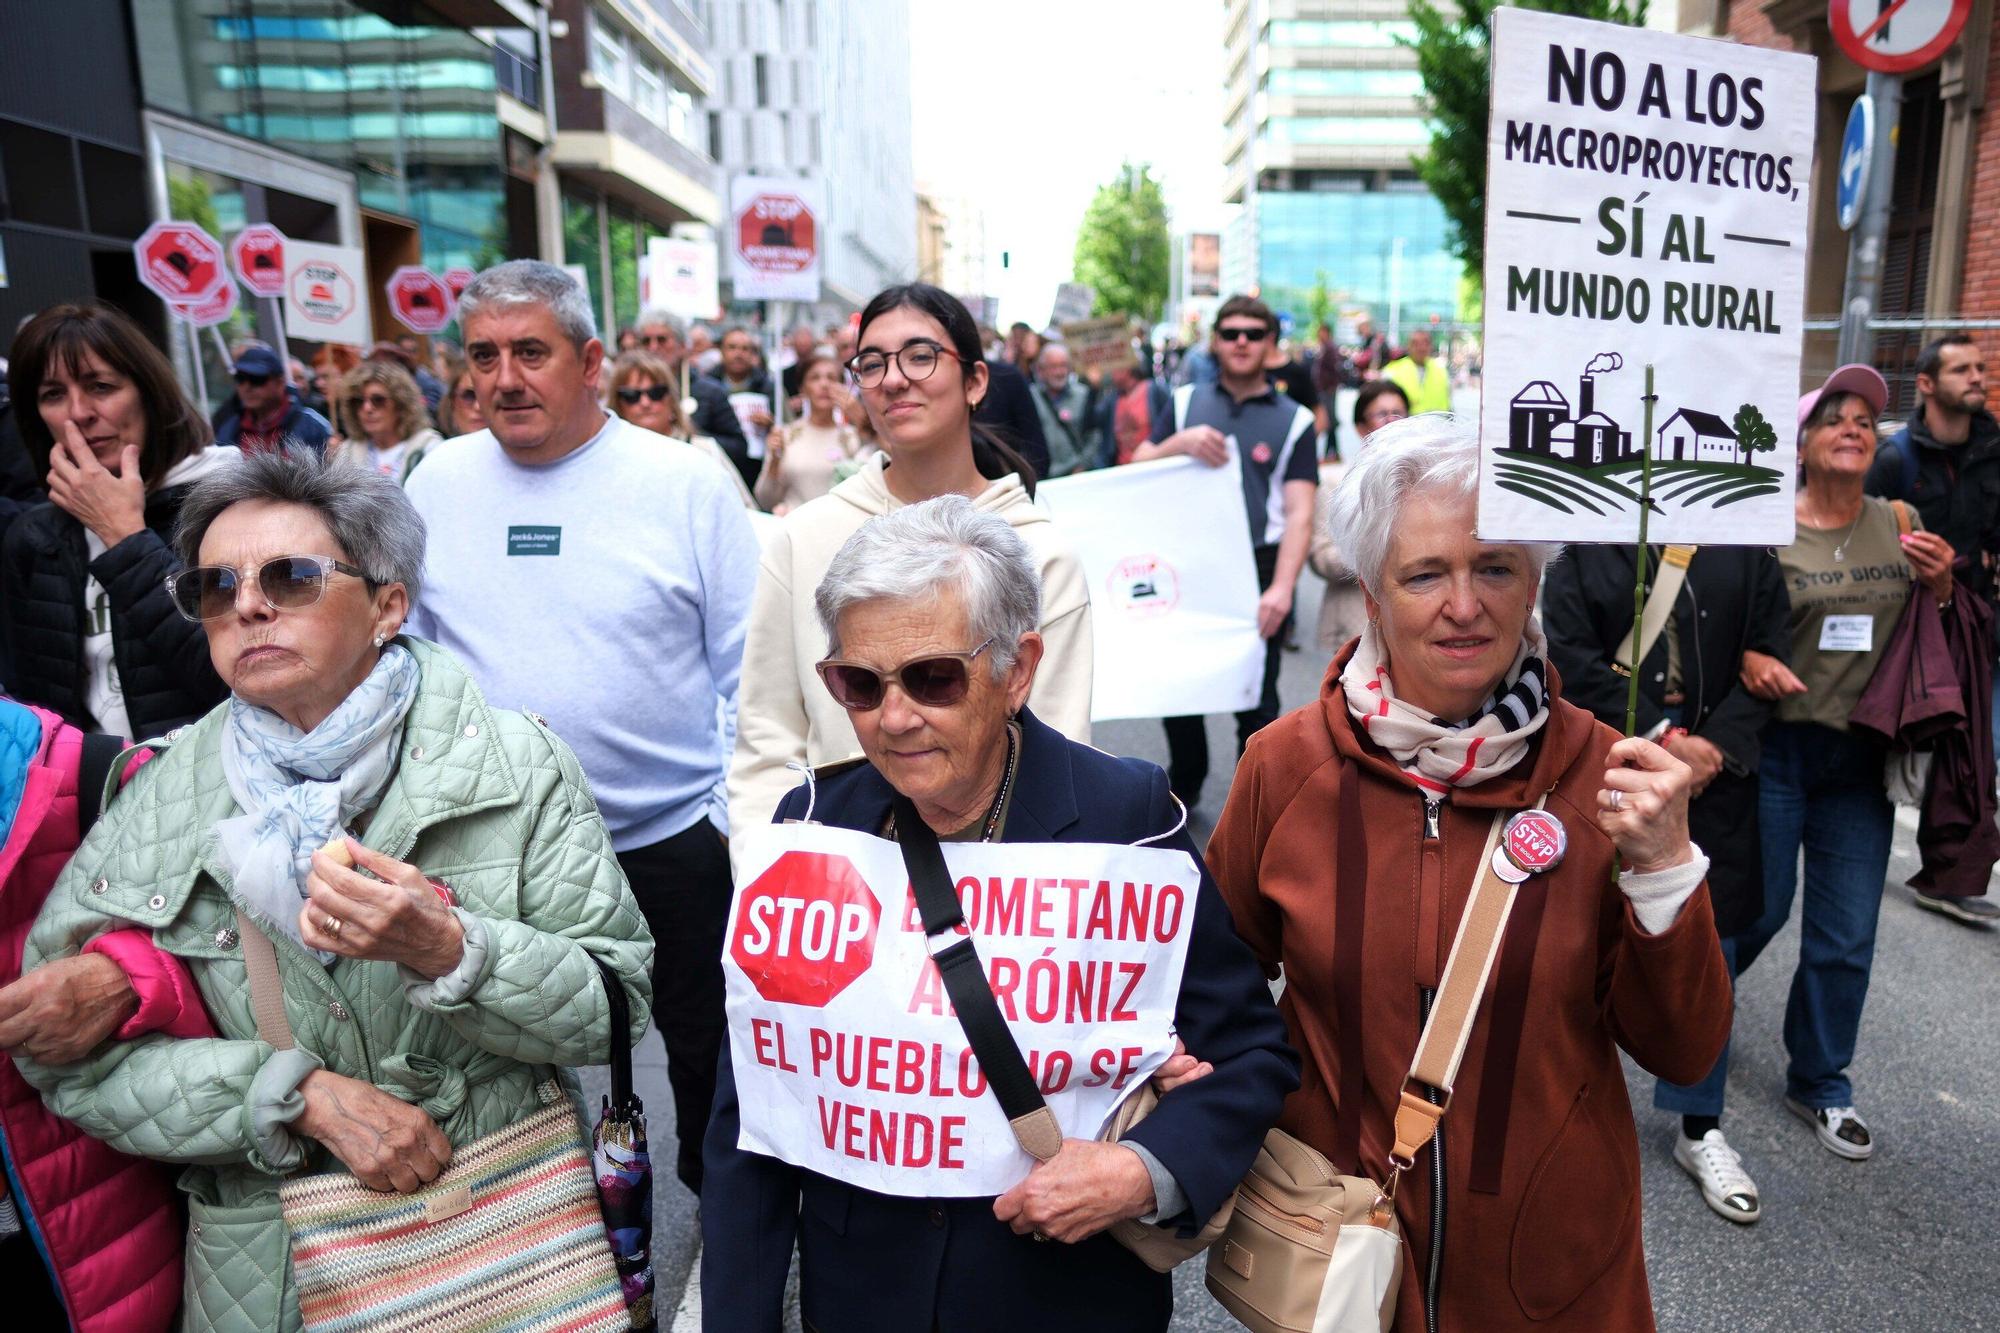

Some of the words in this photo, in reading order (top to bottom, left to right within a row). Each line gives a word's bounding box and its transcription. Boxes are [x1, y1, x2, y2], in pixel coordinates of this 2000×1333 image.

[1548, 43, 1626, 112] NO
[1637, 62, 1671, 119] A
[1686, 68, 1764, 131] LOS
[1505, 119, 1799, 202] MACROPROYECTOS,
[1597, 191, 1650, 258] SÍ
[1660, 213, 1715, 264] AL
[1507, 265, 1650, 324] MUNDO
[1663, 281, 1781, 334] RURAL
[1795, 571, 1844, 590] STOP
[742, 896, 869, 963] STOP
[907, 946, 1148, 1025] ARÓNIZ
[751, 1018, 798, 1074] EL
[809, 1027, 988, 1099] PUEBLO
[1083, 1046, 1143, 1090] SE
[817, 1095, 967, 1170] VENDE
